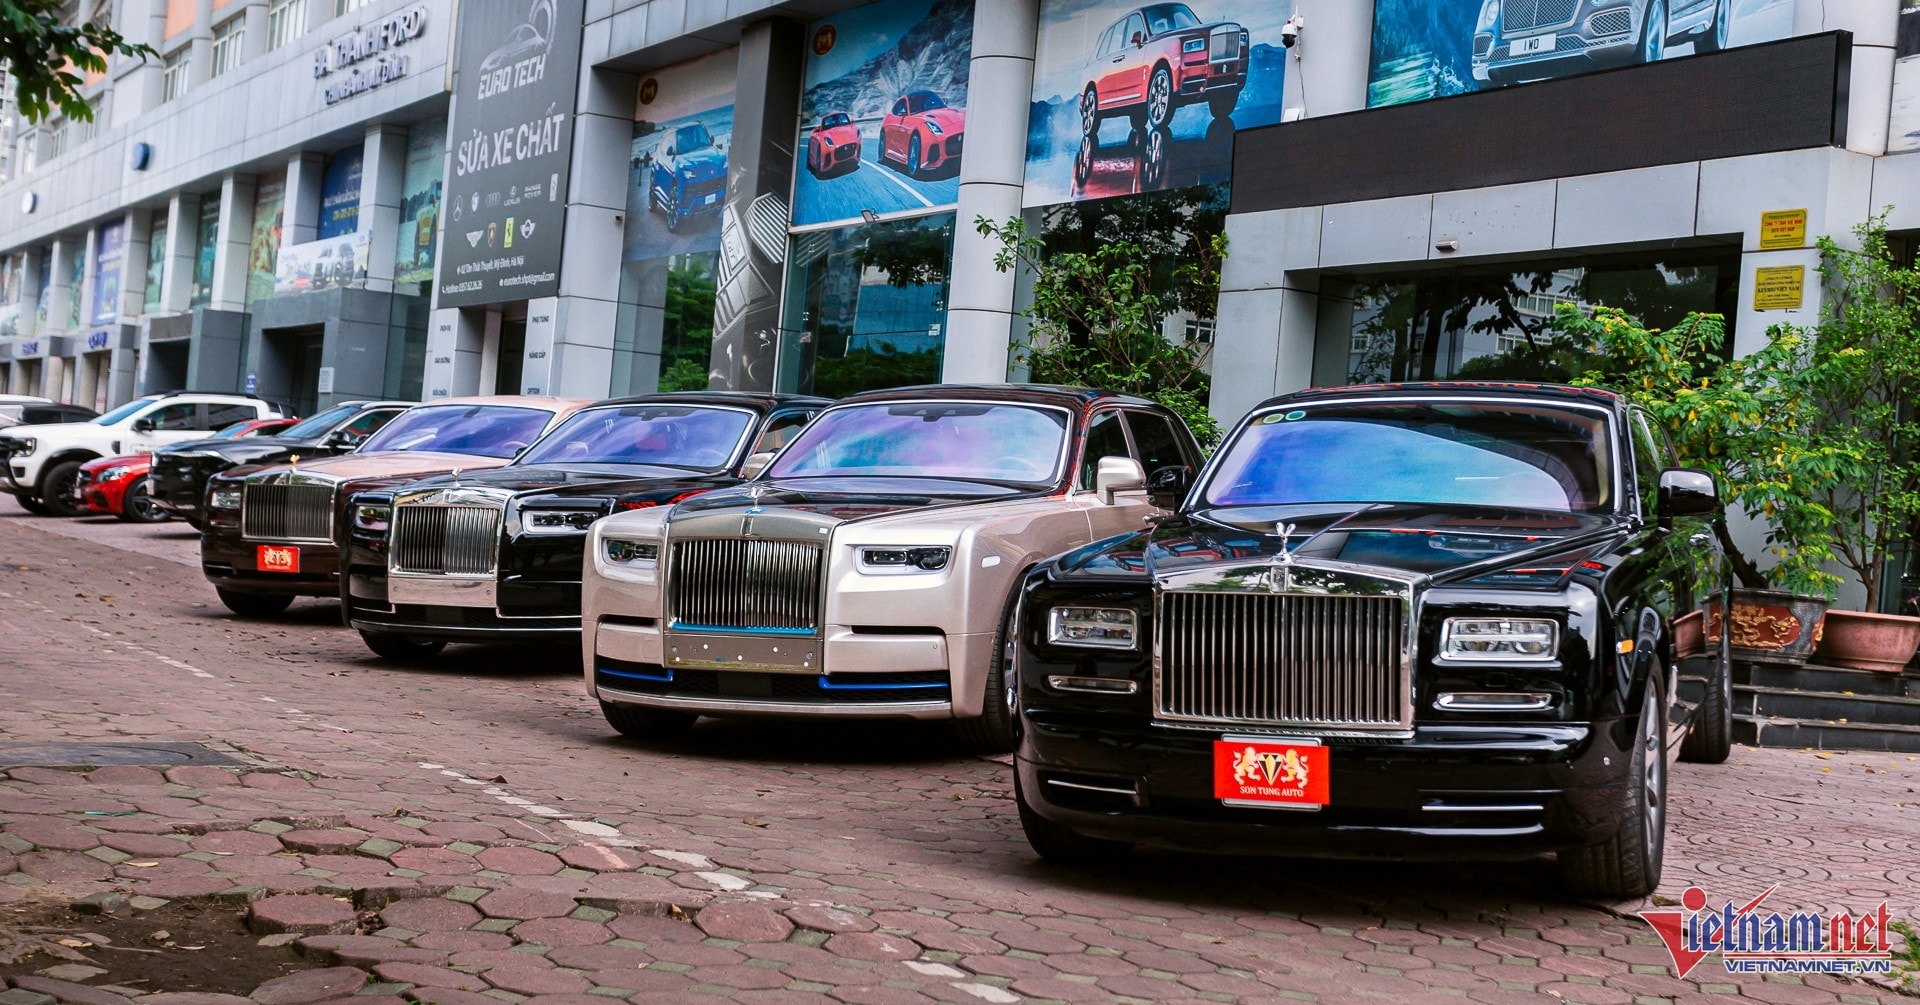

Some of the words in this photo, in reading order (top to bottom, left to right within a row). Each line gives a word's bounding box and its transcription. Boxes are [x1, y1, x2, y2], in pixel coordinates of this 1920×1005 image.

[380, 5, 427, 51] FORD
[478, 65, 512, 101] EURO
[513, 53, 547, 89] TECH
[456, 127, 489, 177] SỬA
[491, 127, 514, 168] XE
[515, 101, 565, 161] CHẤT
[503, 196, 521, 206] LEXUS
[1240, 785, 1257, 795] SON
[1257, 786, 1280, 796] TUNG
[1281, 788, 1304, 797] AUTO
